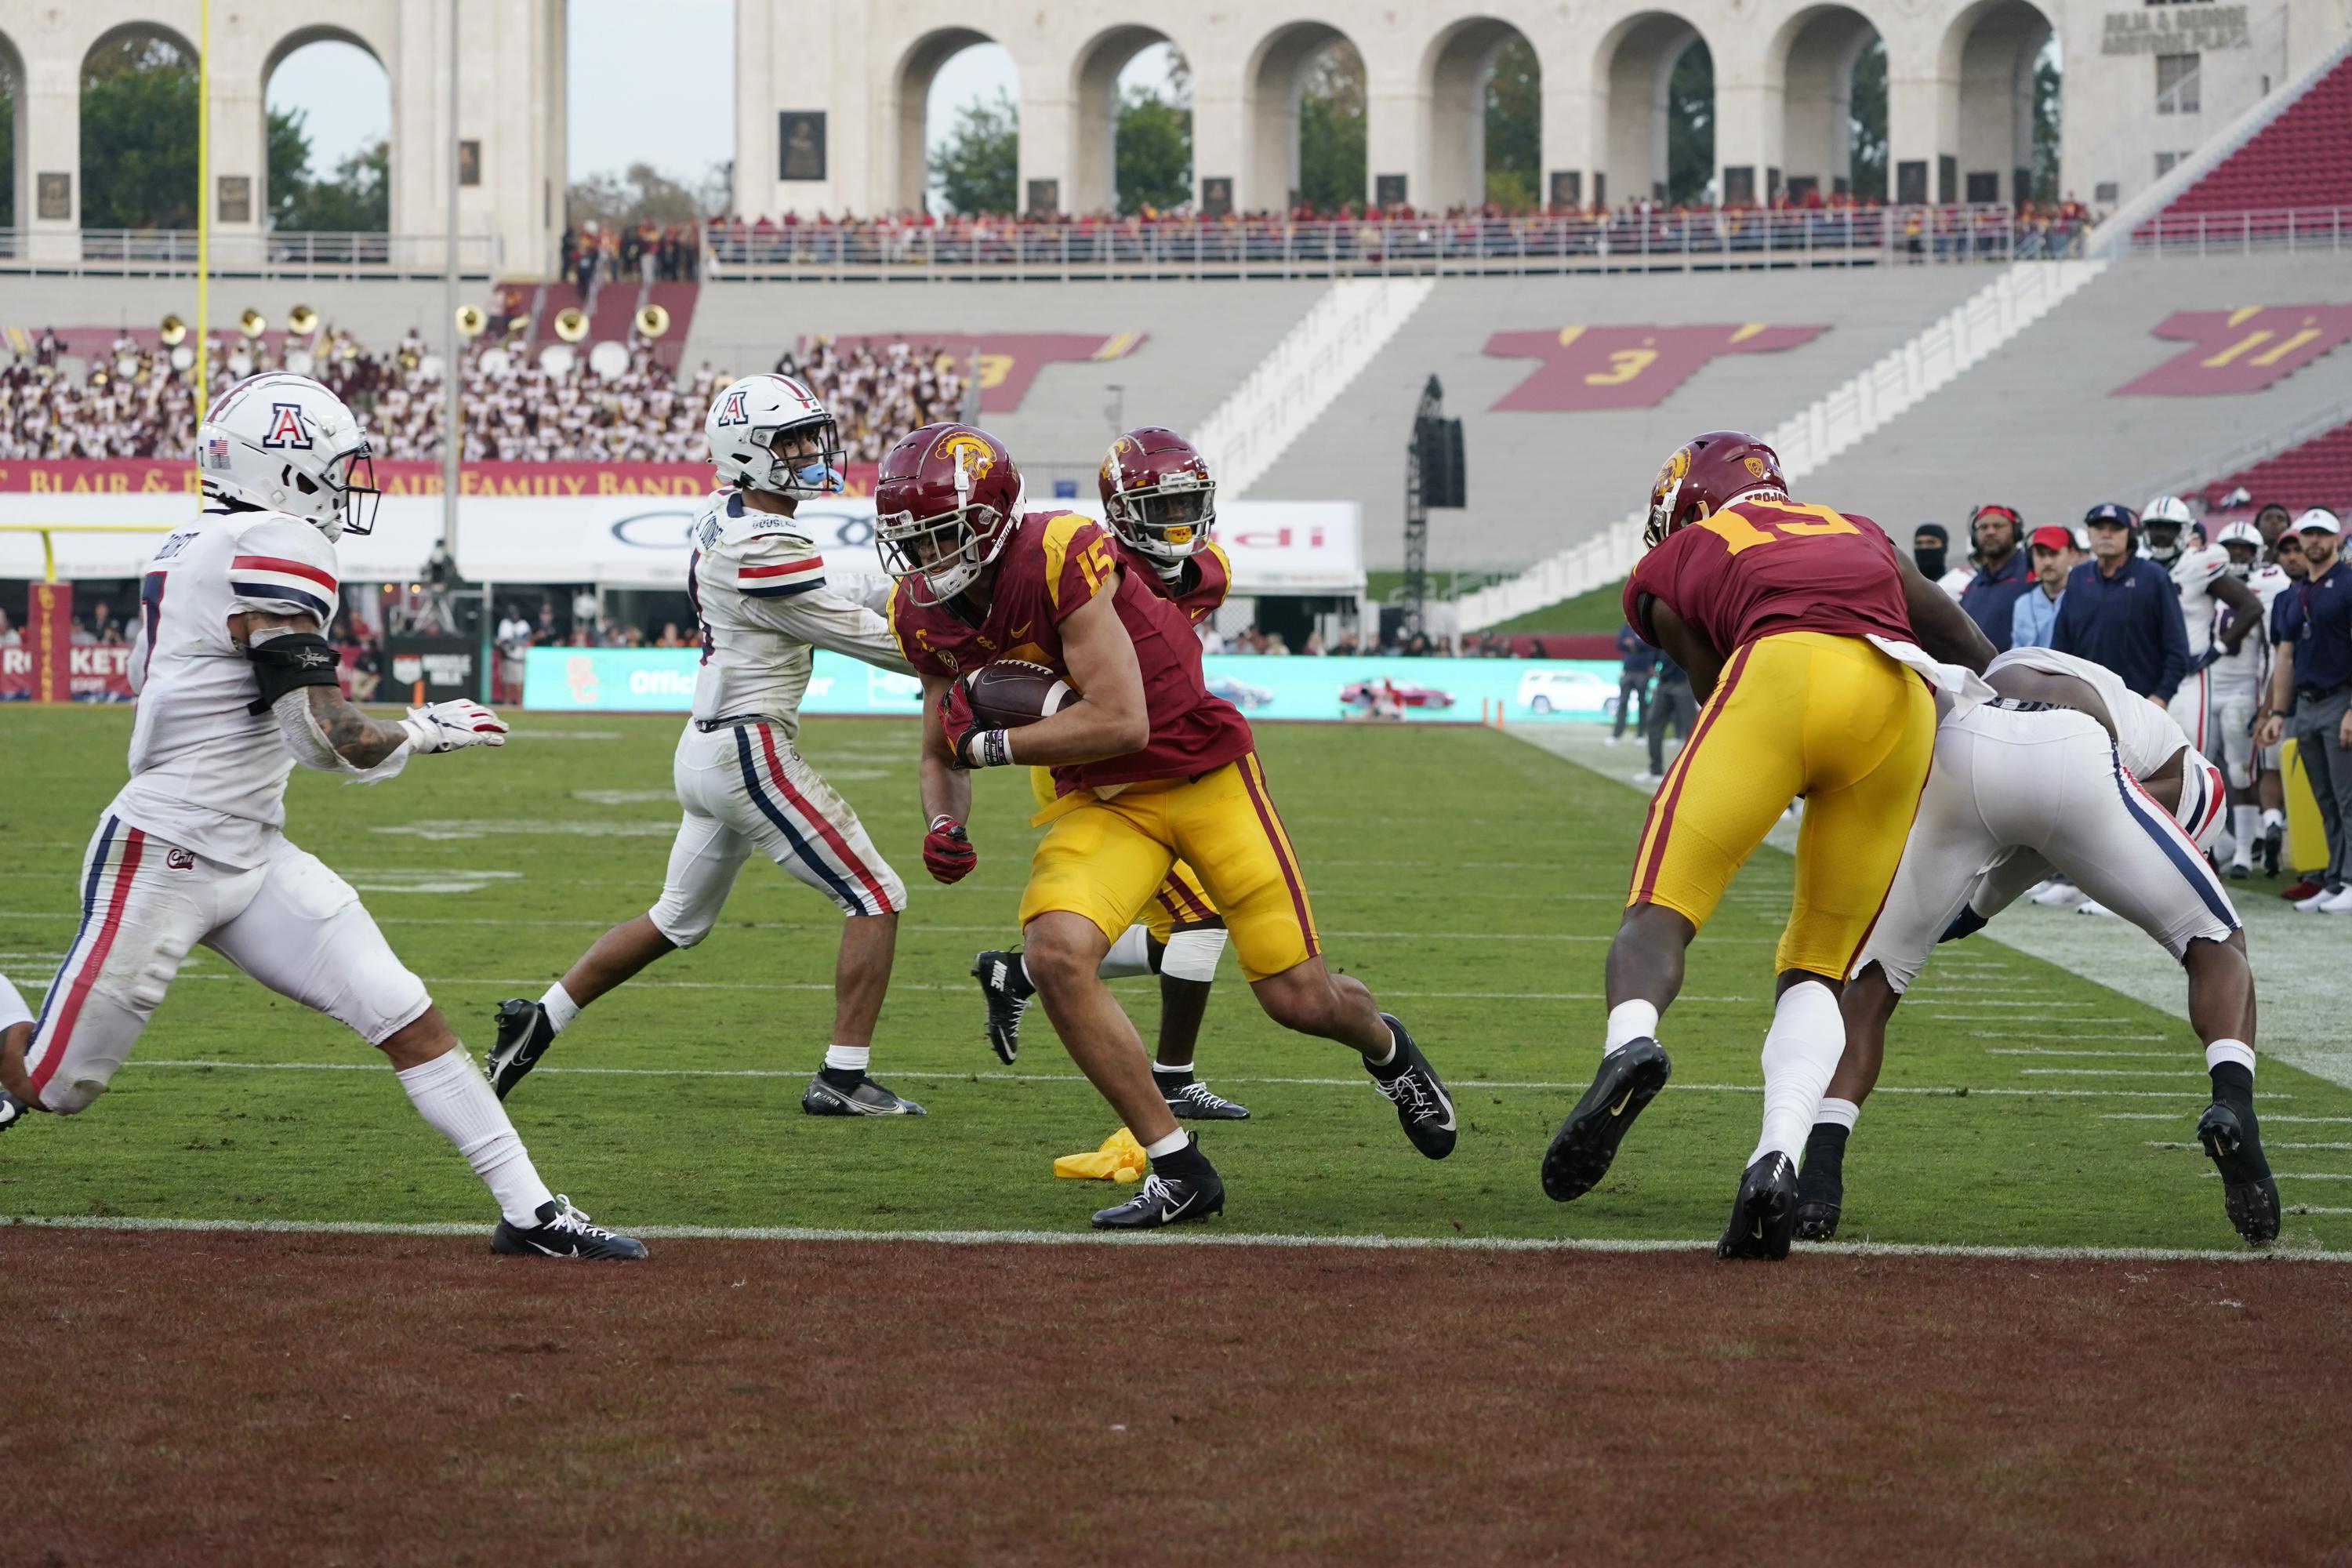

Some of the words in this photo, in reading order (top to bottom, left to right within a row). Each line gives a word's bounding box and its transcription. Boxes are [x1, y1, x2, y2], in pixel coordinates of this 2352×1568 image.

[1584, 349, 1658, 385] 3
[719, 392, 750, 426] A
[263, 403, 314, 450] A
[460, 471, 584, 496] FAMILY
[598, 473, 700, 496] BAND
[1076, 535, 1115, 597] 15
[629, 668, 698, 694] Offici
[991, 960, 1007, 992] NIKE
